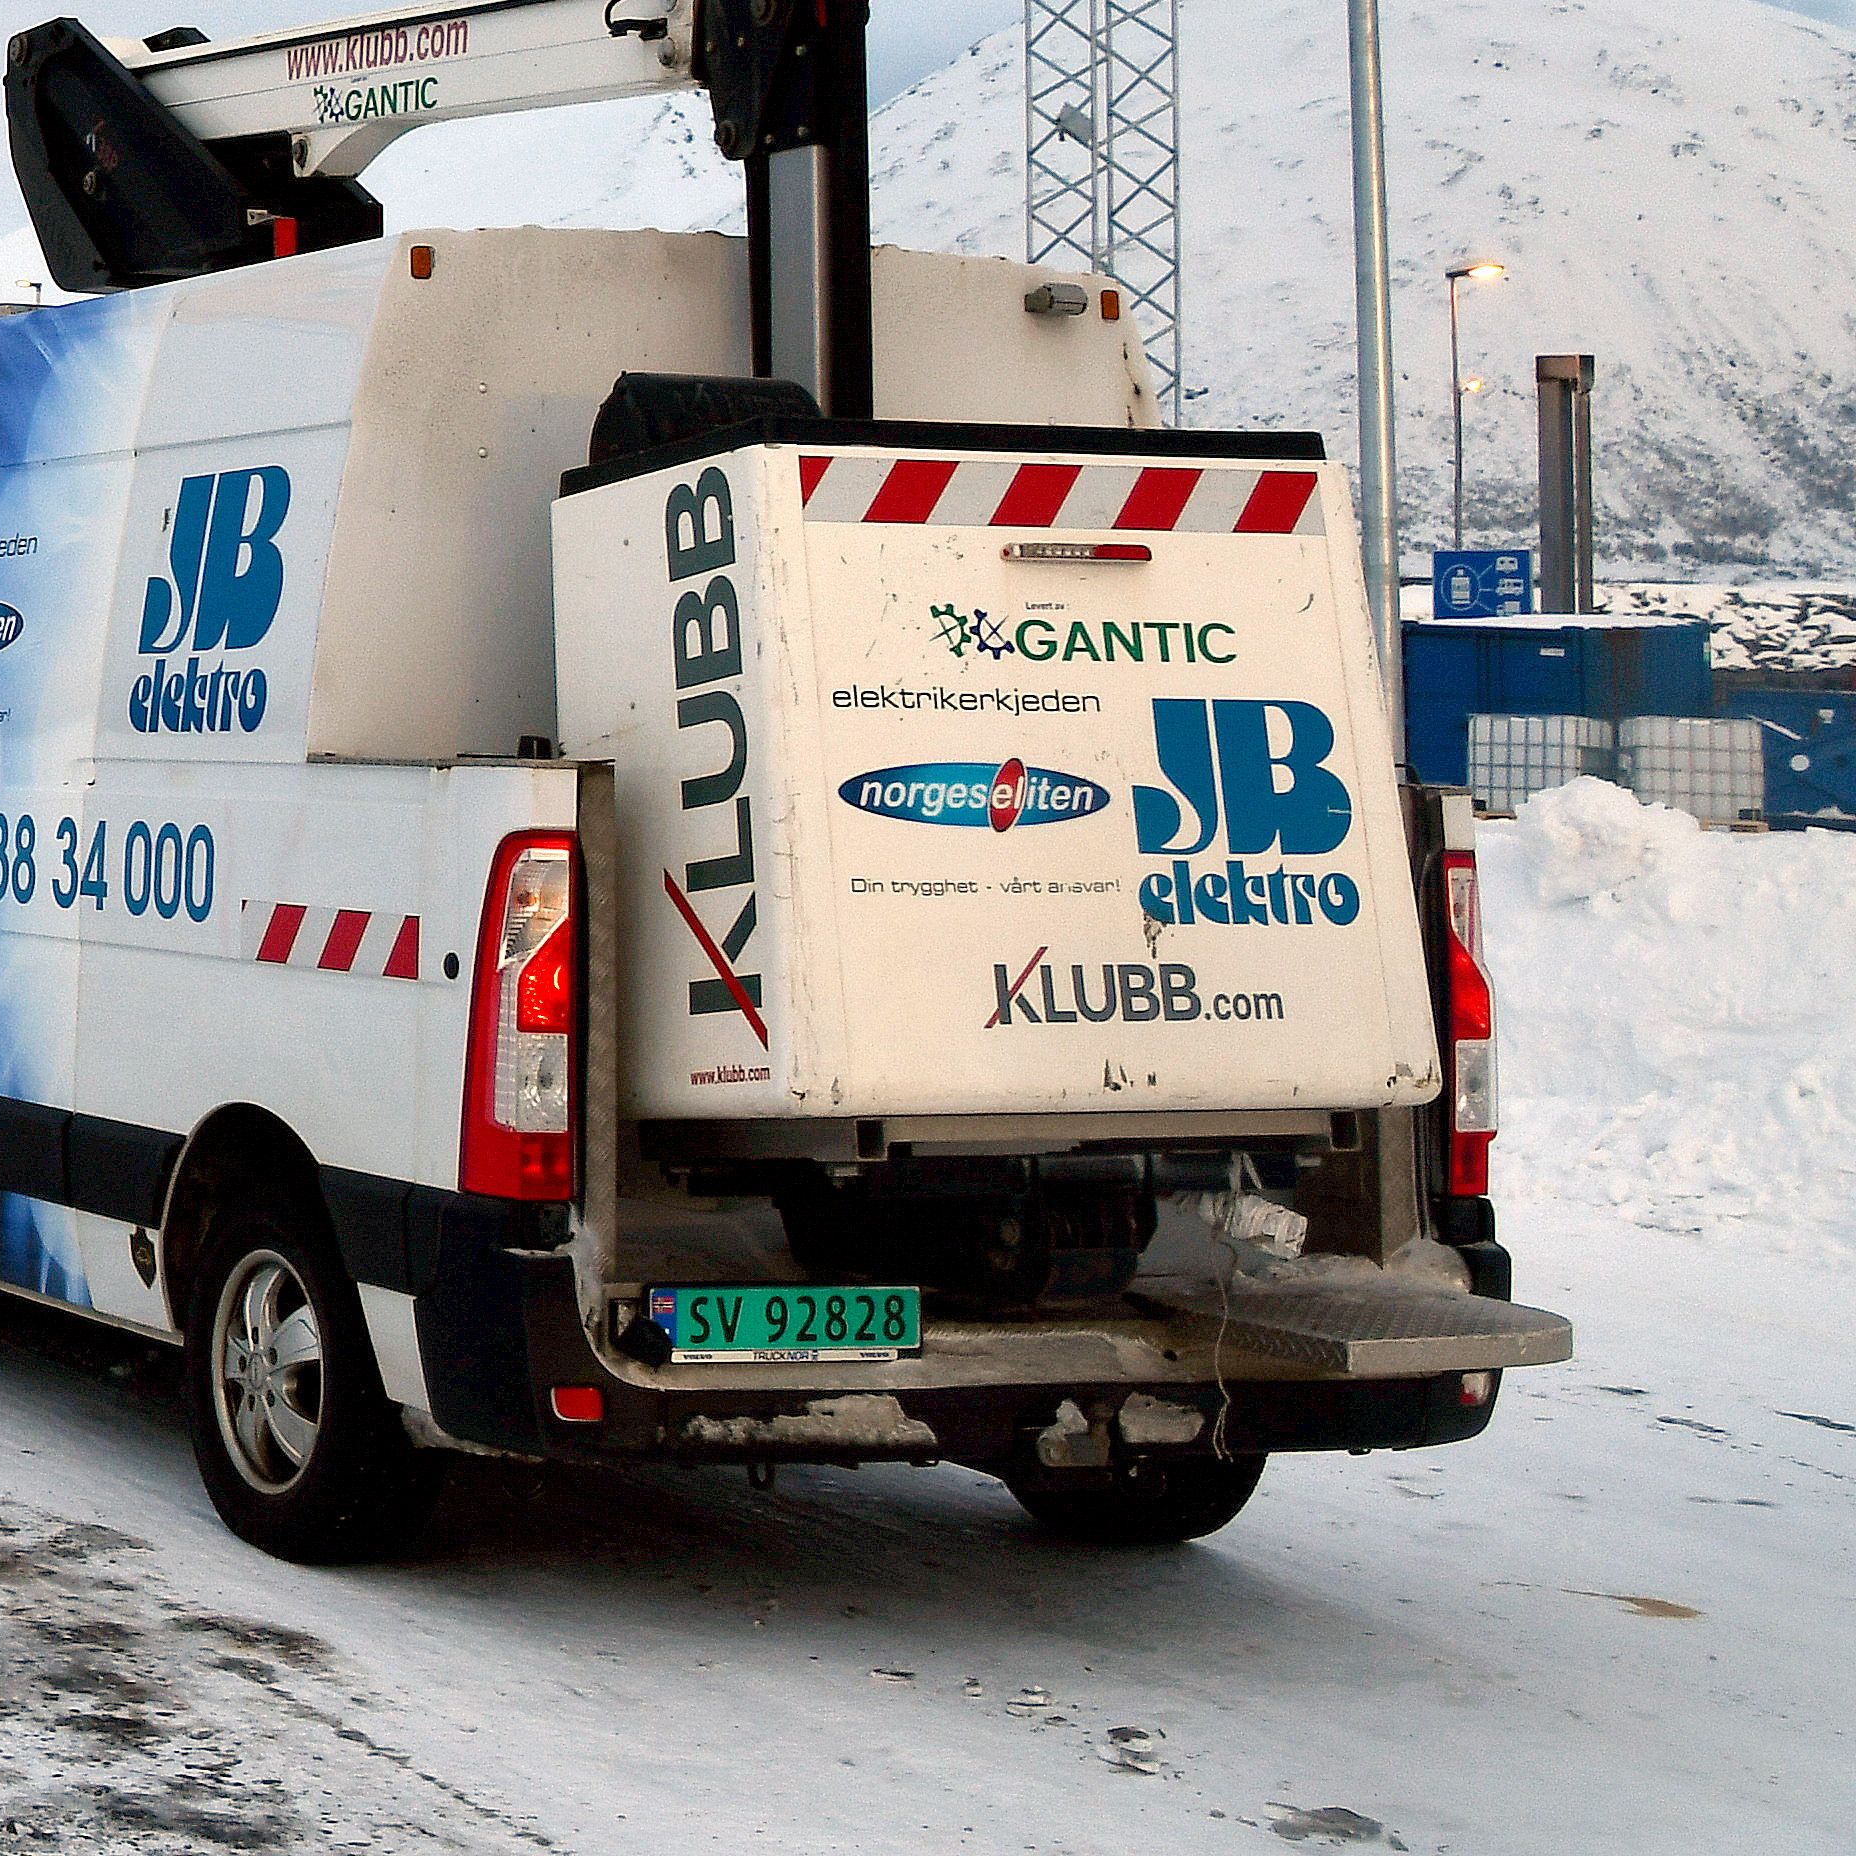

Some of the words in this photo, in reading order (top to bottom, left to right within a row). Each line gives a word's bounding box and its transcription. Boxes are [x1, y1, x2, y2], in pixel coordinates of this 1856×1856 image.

[288, 19, 468, 80] www.klubb.com
[344, 76, 439, 121] GANTIC
[1015, 619, 1238, 664] GANTIC
[128, 656, 268, 734] elektro
[832, 685, 1101, 717] elektrikerkjeden
[664, 464, 769, 1052] KLUBB
[859, 776, 1094, 817] norgeseliten
[51, 816, 108, 911] 34
[124, 819, 215, 923] 000
[850, 877, 884, 894] Din
[891, 879, 978, 897] trygghet
[1000, 876, 1042, 894] vårt
[1138, 860, 1360, 927] elektro
[983, 945, 1286, 1030] KLUBB.com
[690, 1063, 771, 1086] www.klubb.com
[689, 1294, 743, 1344] SV
[765, 1294, 907, 1342] 92828
